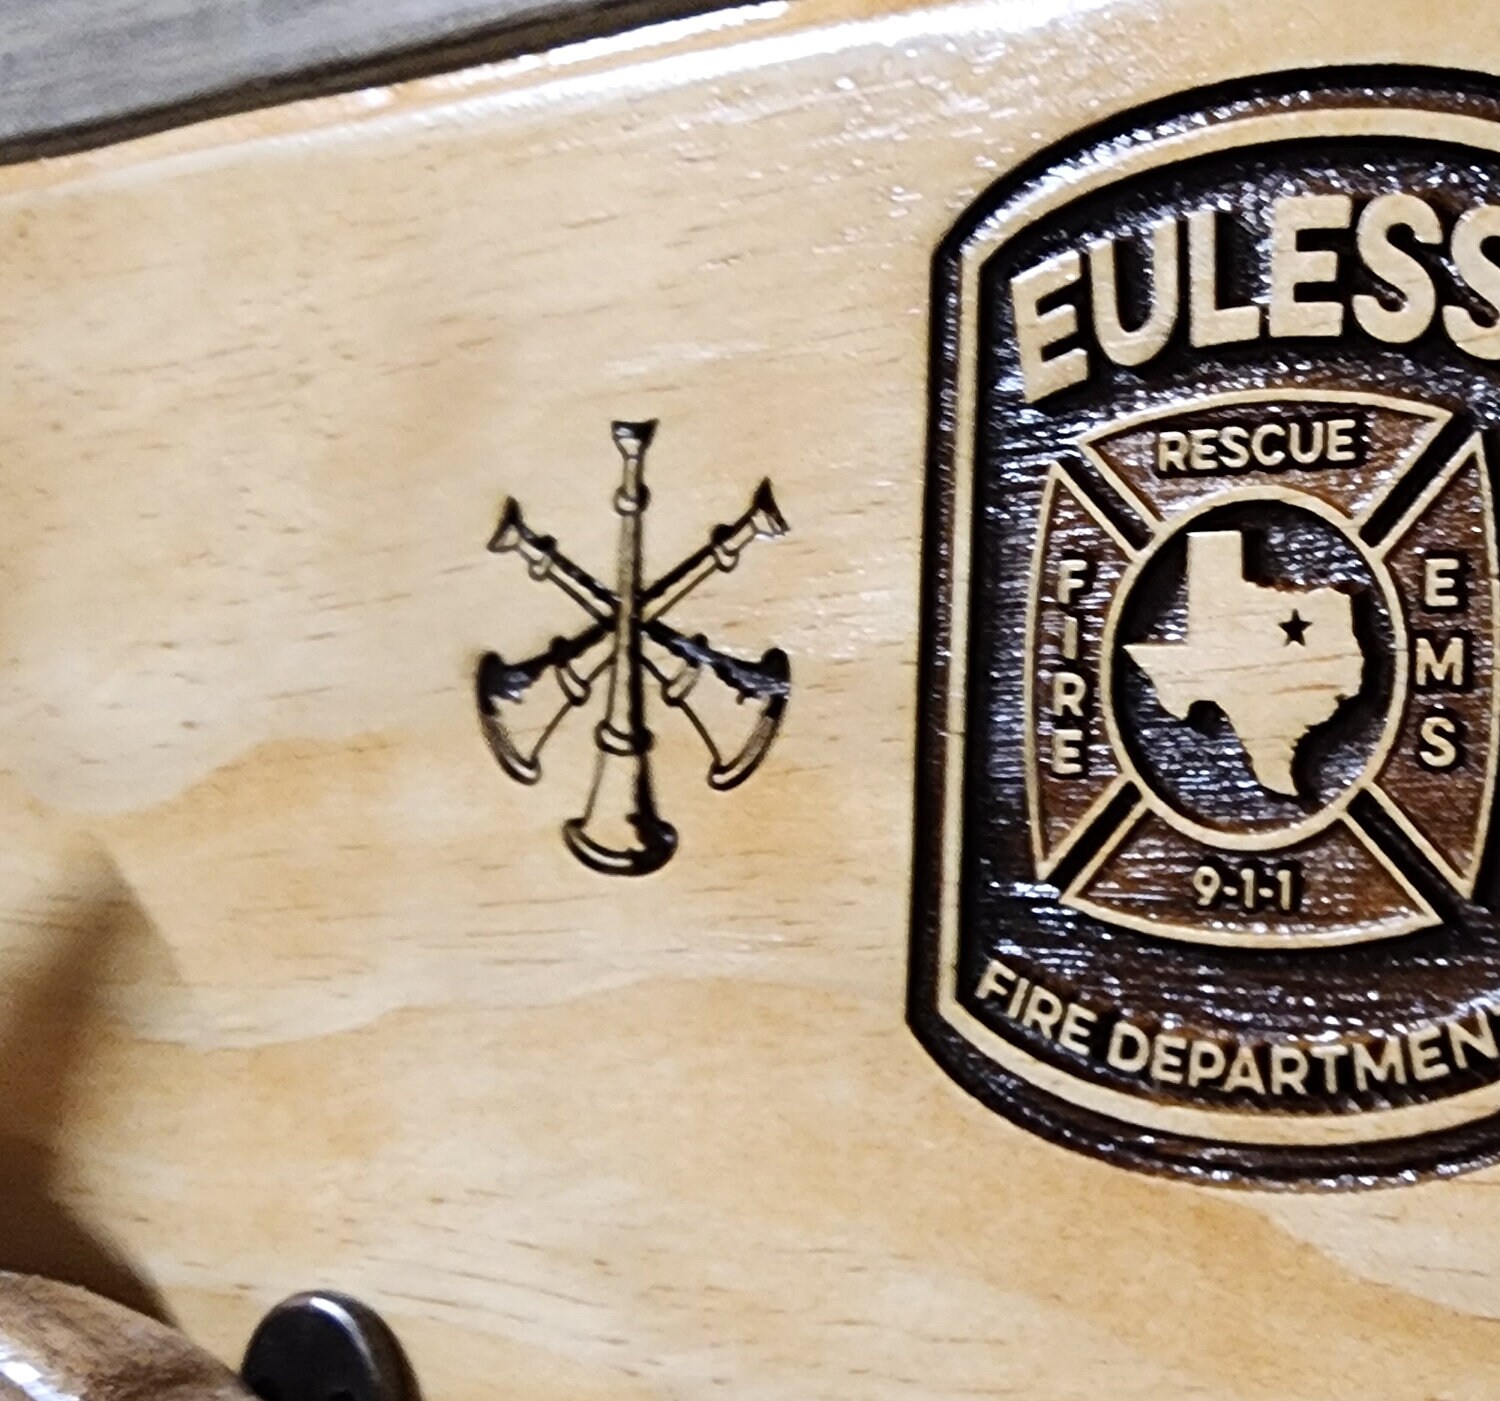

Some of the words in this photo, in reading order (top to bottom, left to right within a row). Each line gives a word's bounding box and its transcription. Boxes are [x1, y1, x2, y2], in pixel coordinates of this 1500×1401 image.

[1158, 419, 1357, 472] RESCUE
[1051, 559, 1088, 774] FIRE
[1416, 558, 1464, 767] EMS
[1193, 866, 1292, 910] 9-1-1
[974, 959, 1097, 1055] FIRE
